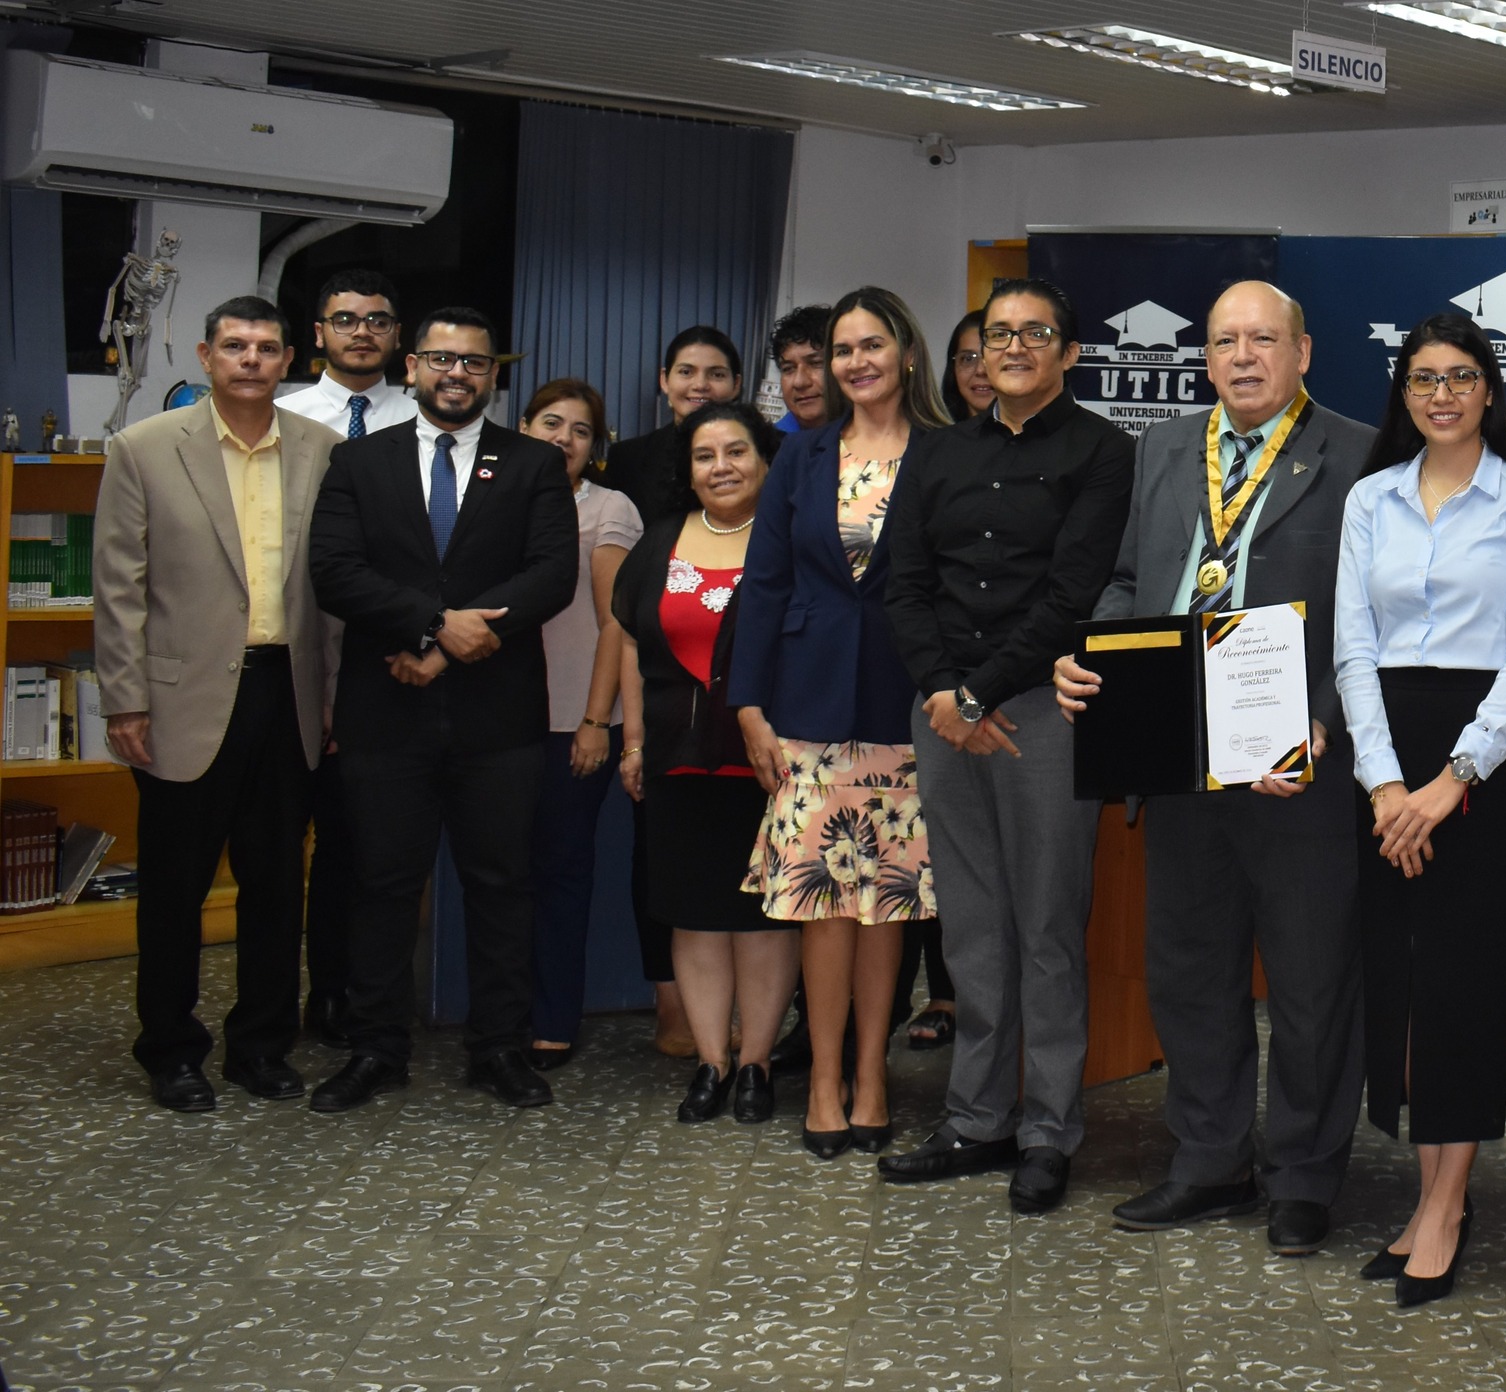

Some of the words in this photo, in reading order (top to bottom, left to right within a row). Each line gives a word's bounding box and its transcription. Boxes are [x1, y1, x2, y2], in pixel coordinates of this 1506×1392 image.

[1298, 48, 1383, 83] SILENCIO
[1080, 345, 1098, 355] LUX
[1119, 352, 1128, 360] IN
[1131, 353, 1174, 362] TENEBRIS
[1100, 369, 1196, 401] UTIC
[1109, 406, 1181, 419] UNIVERSIDAD
[1217, 643, 1290, 659] Reconocimiento
[1238, 671, 1254, 680] HUGO
[1255, 667, 1283, 677] FERREIRA
[1240, 677, 1271, 687] GONZÁLEZ
